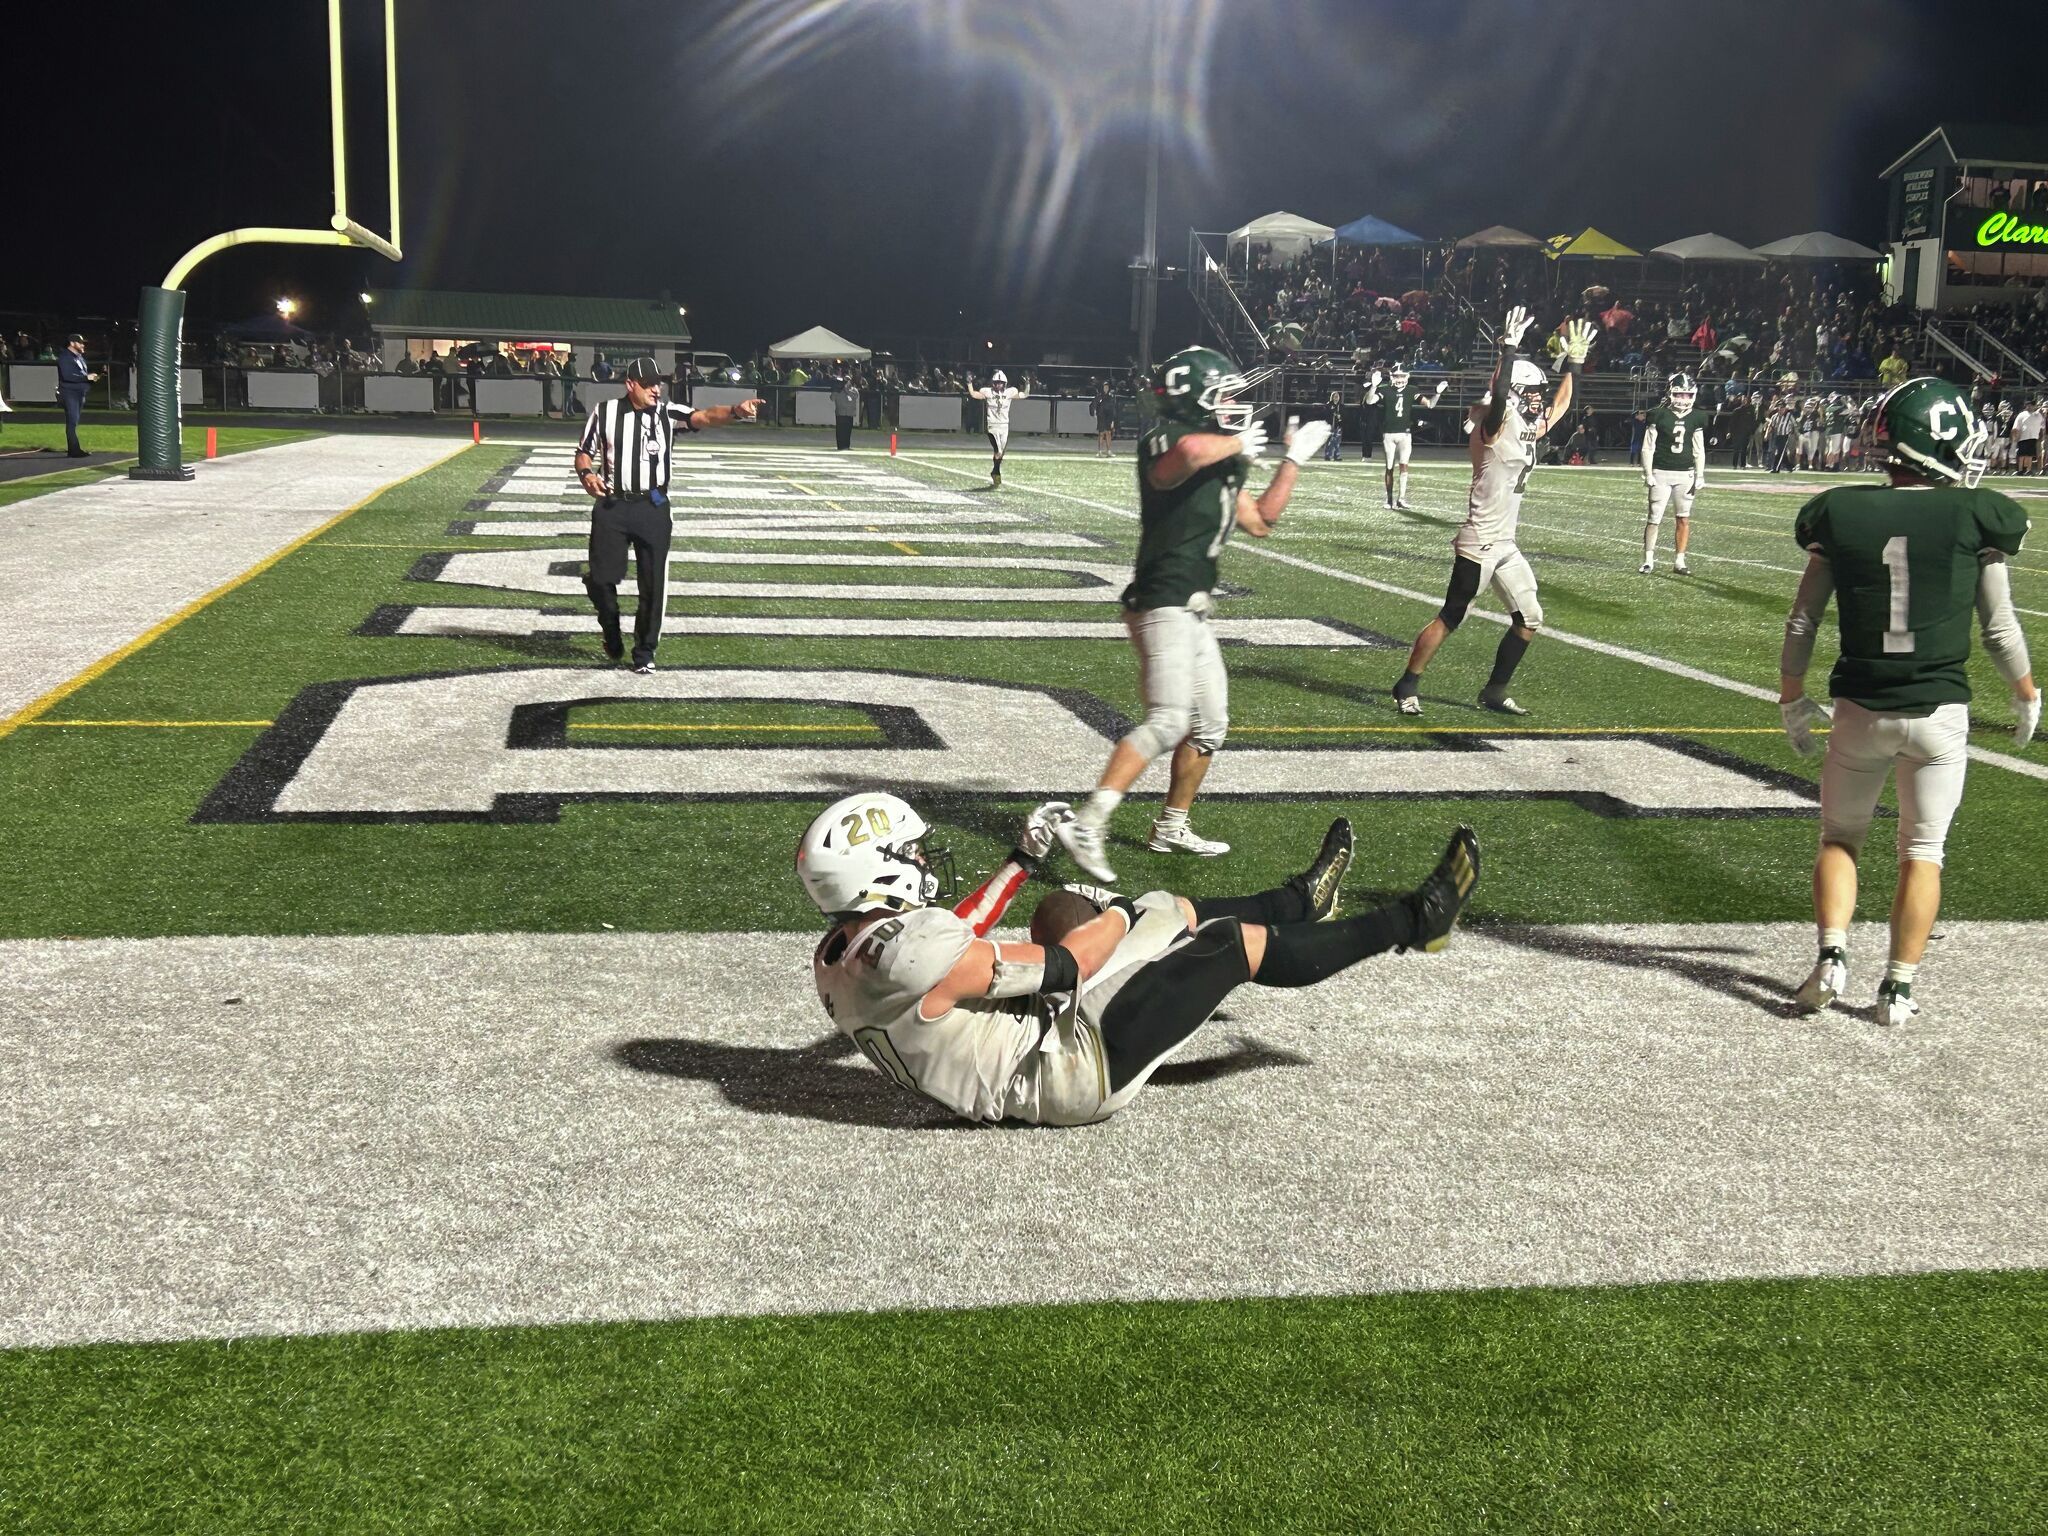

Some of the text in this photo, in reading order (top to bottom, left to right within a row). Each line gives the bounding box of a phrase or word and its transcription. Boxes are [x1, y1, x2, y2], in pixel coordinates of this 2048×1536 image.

[1165, 365, 1190, 396] C
[1395, 396, 1404, 417] 4
[1929, 401, 1957, 440] C
[1150, 434, 1169, 456] 11
[1671, 425, 1686, 454] 3
[1513, 444, 1535, 494] 2
[1882, 536, 1915, 653] 1
[841, 807, 892, 847] 20
[855, 918, 905, 970] 20
